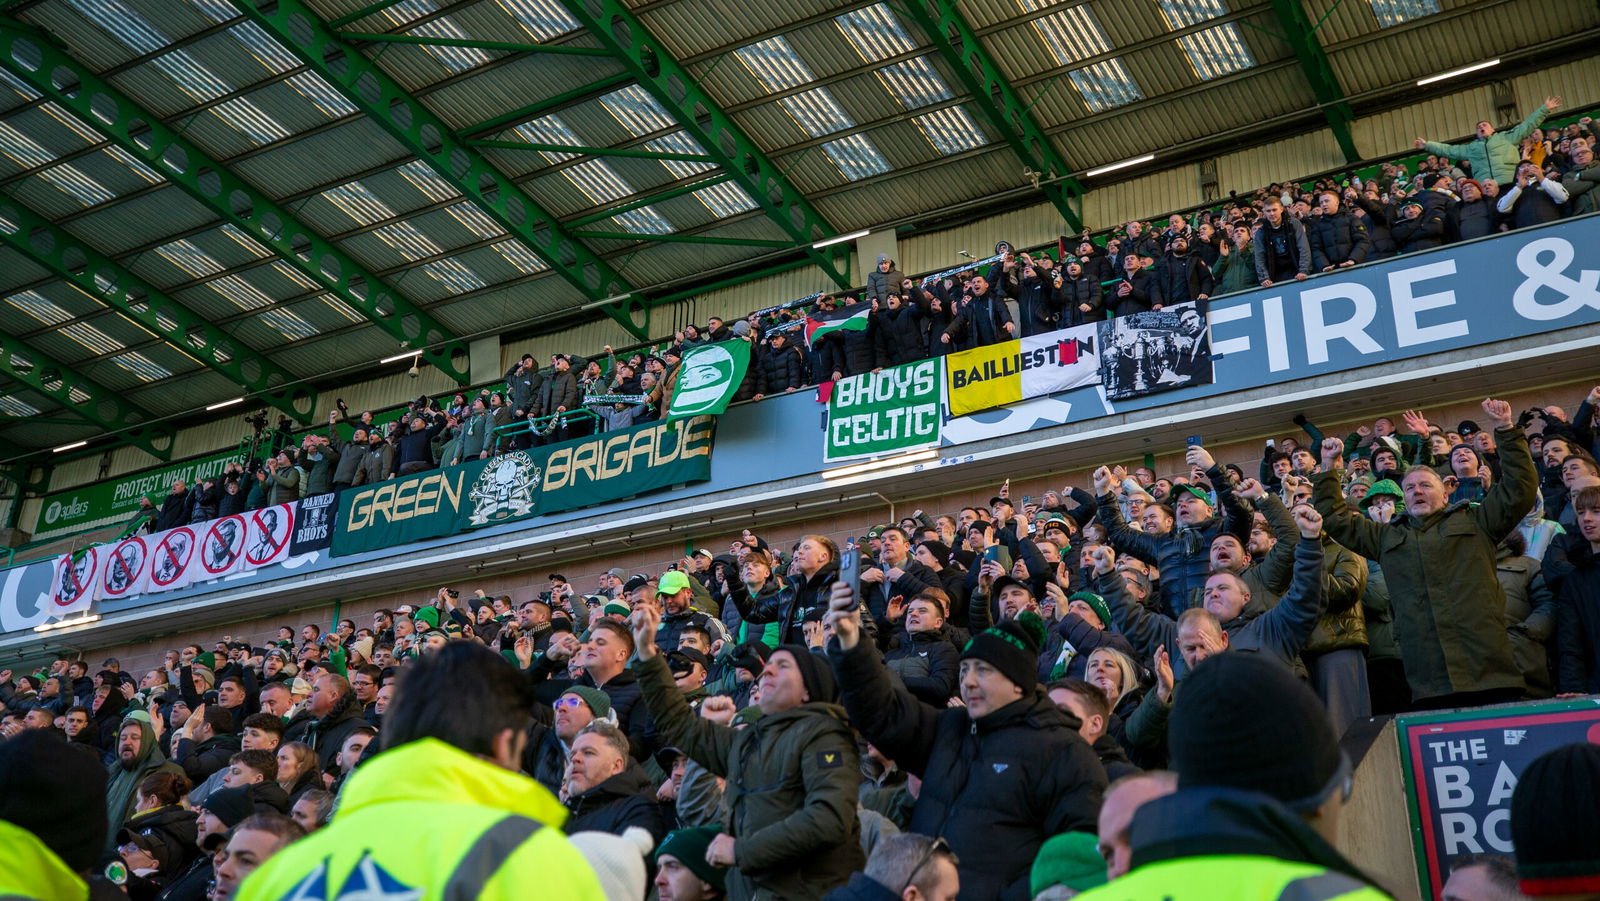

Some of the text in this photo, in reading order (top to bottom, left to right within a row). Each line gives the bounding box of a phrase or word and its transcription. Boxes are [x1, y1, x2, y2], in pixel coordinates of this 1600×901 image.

[1207, 236, 1600, 385] FIRE &
[836, 360, 935, 408] BHOYS
[953, 335, 1095, 389] BAILLIESTN
[832, 402, 936, 447] CELTIC
[113, 473, 162, 501] PROTECT
[162, 465, 195, 488] WHAT
[347, 414, 711, 532] GREEN BRIGADE
[480, 450, 534, 481] GREEN BRIGADE
[301, 493, 335, 509] BANNED
[296, 524, 328, 544] BHOYS
[1428, 738, 1488, 763] THE
[1433, 759, 1519, 809] BA
[1440, 808, 1516, 855] RO
